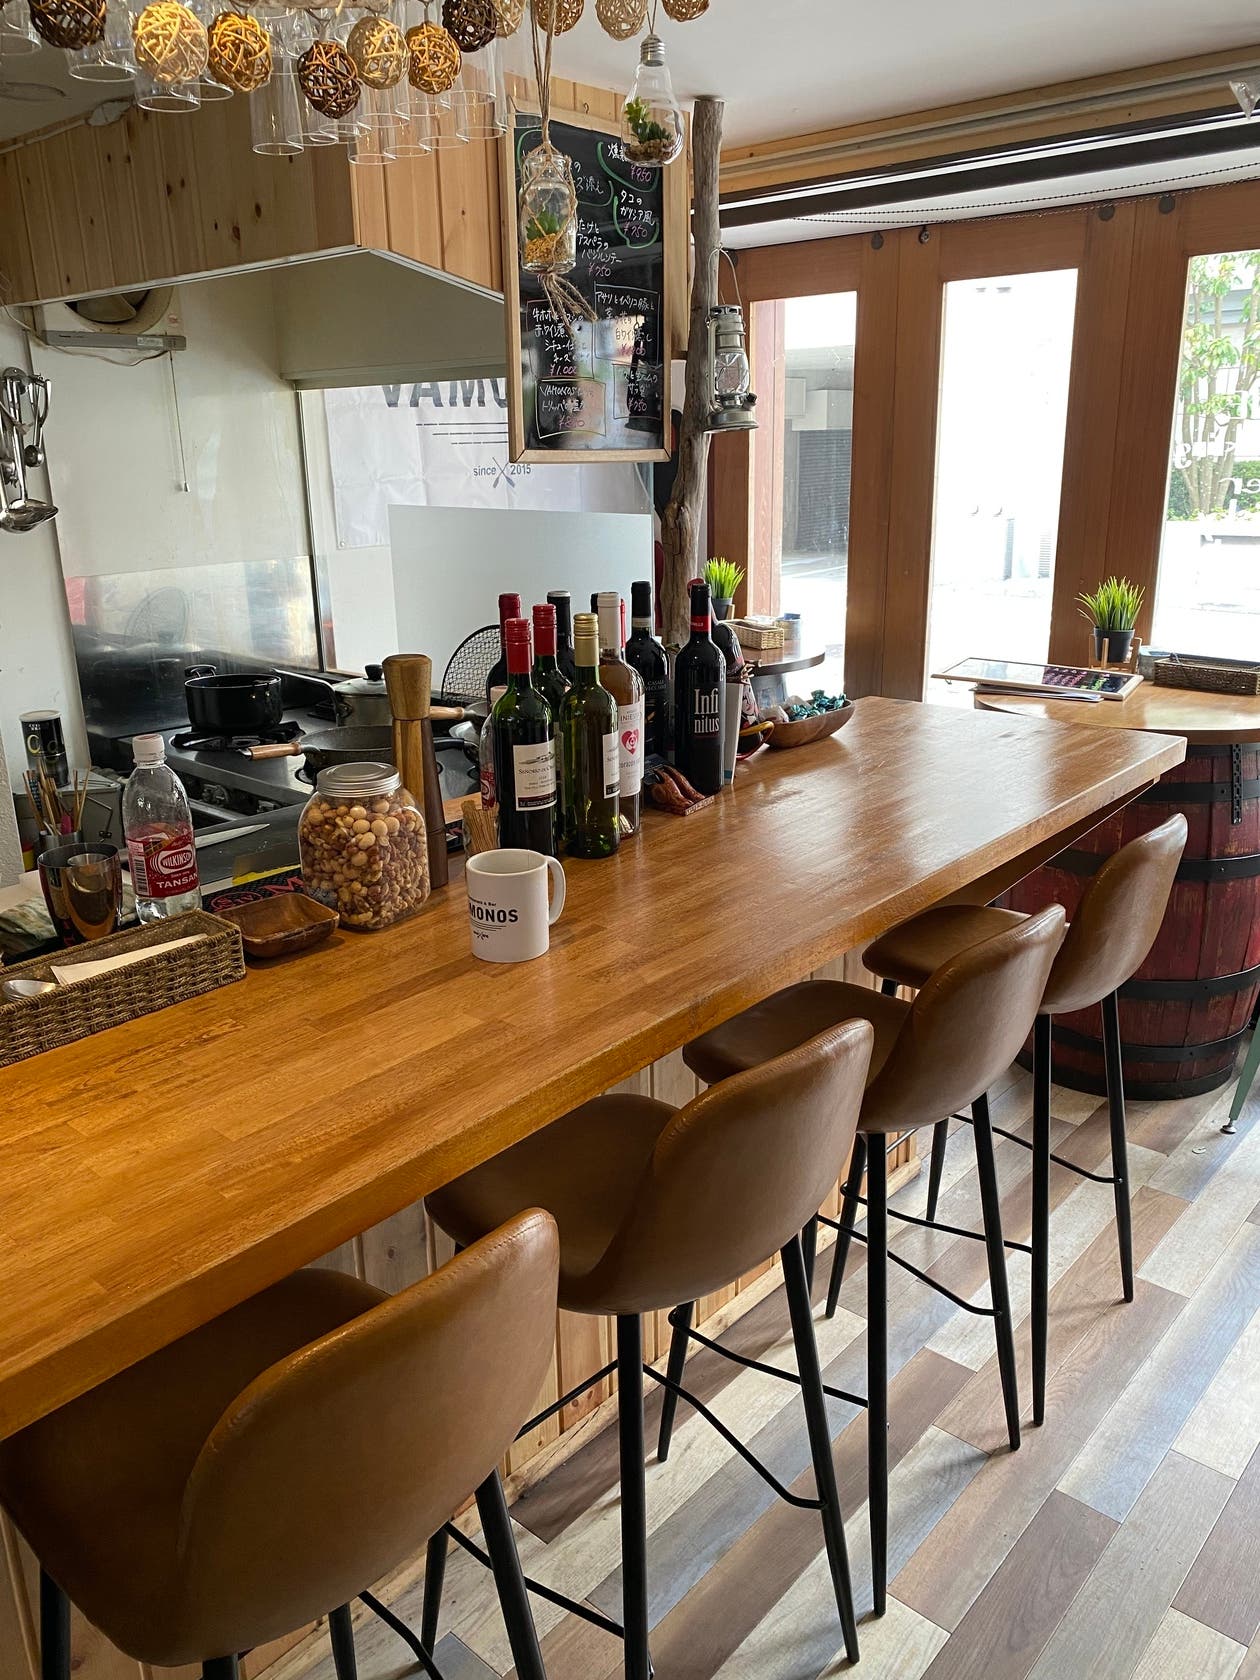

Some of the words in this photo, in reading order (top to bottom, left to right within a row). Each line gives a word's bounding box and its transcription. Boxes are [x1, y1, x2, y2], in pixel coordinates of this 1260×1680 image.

[473, 465, 497, 477] since
[510, 464, 532, 475] 2015
[694, 688, 719, 715] Infi
[694, 716, 720, 734] nitus
